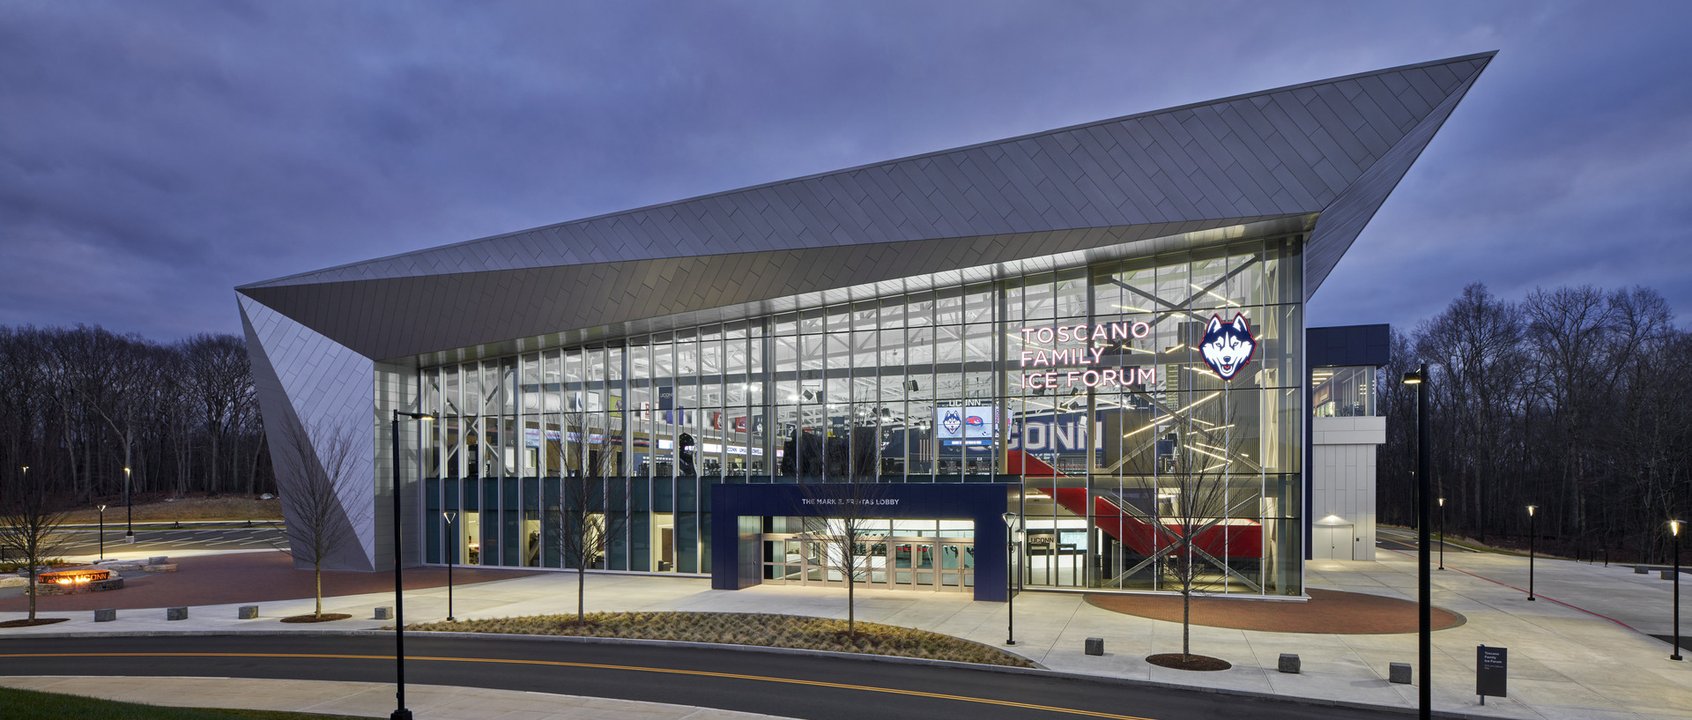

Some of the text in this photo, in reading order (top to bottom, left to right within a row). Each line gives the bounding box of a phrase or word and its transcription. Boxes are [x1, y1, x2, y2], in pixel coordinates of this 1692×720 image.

[1021, 321, 1151, 344] TOSCANO
[1020, 347, 1105, 367] FAMILY
[1021, 368, 1156, 389] ICE FORUM
[990, 421, 1103, 450] CONN
